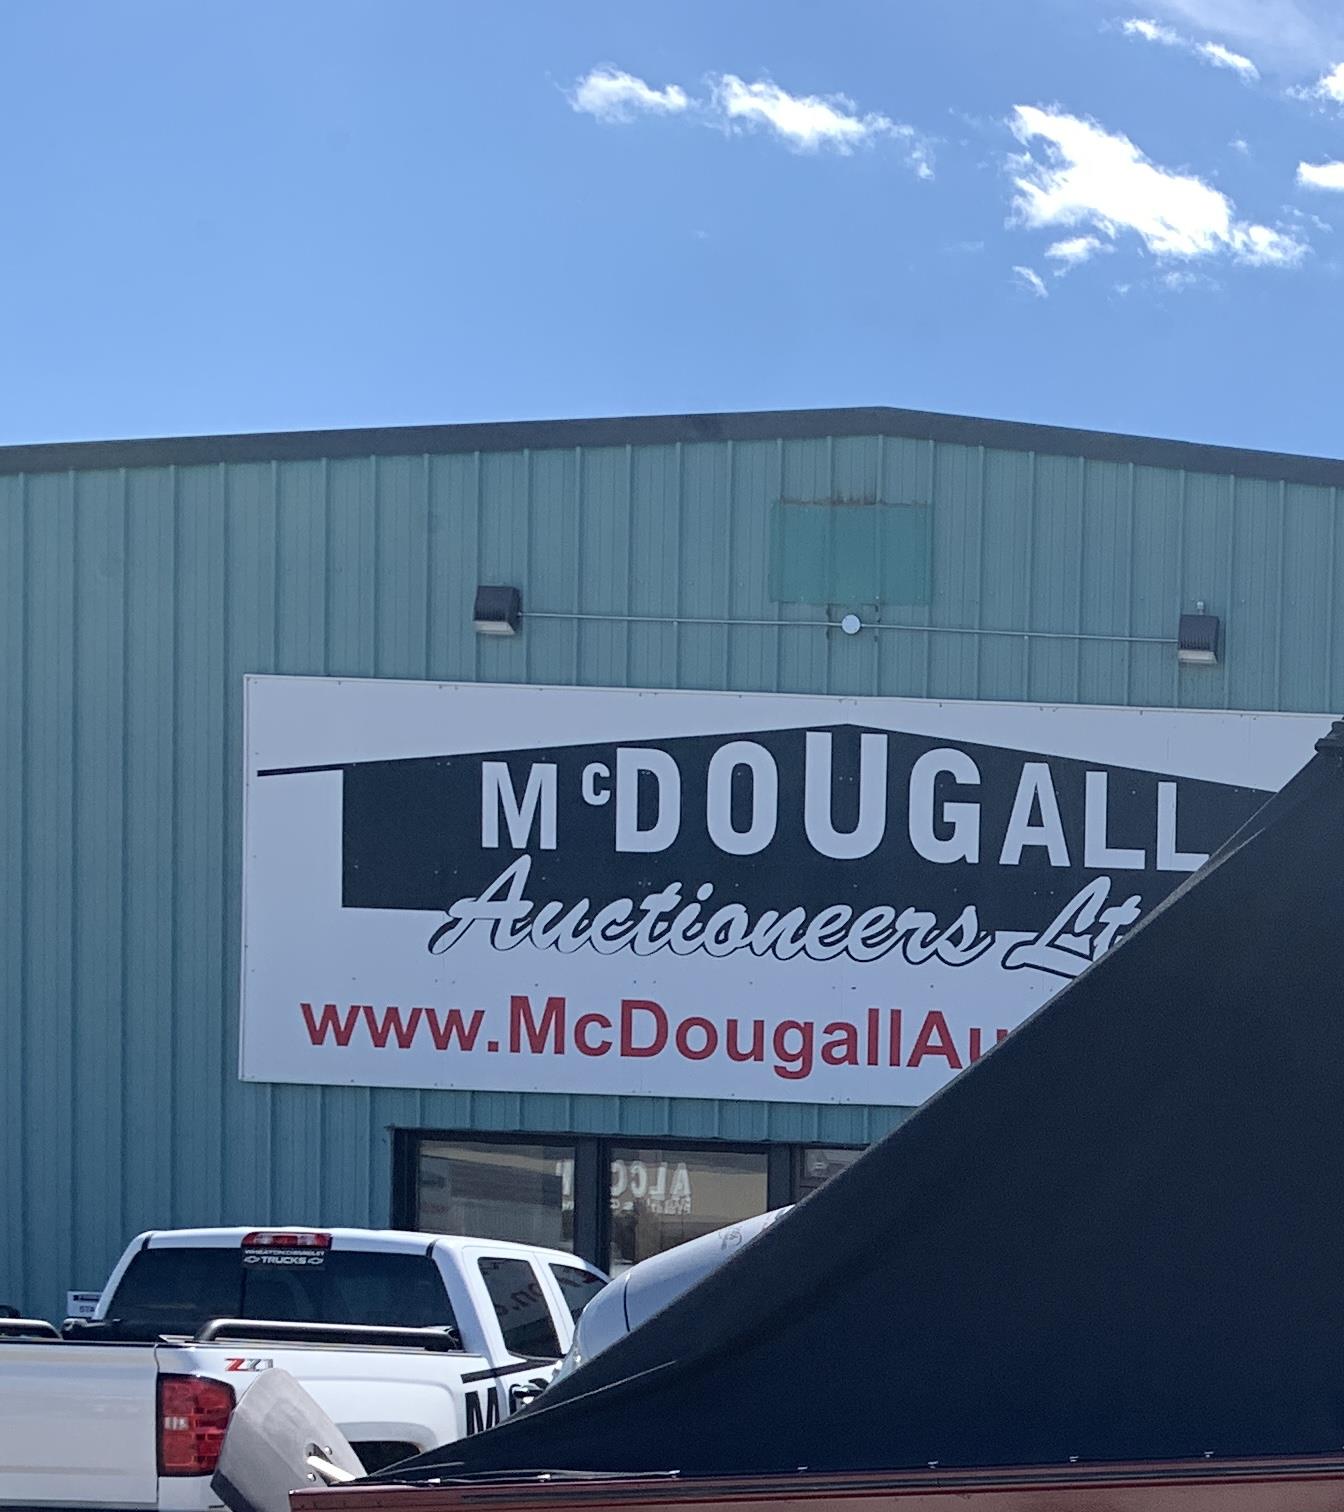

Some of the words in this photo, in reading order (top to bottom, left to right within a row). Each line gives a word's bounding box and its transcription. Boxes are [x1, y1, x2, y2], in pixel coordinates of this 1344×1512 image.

[261, 256, 307, 265] TRUCKS
[481, 731, 1209, 871] McDOUGALL
[430, 854, 992, 966] Auctioneers
[225, 1358, 274, 1372] Z71
